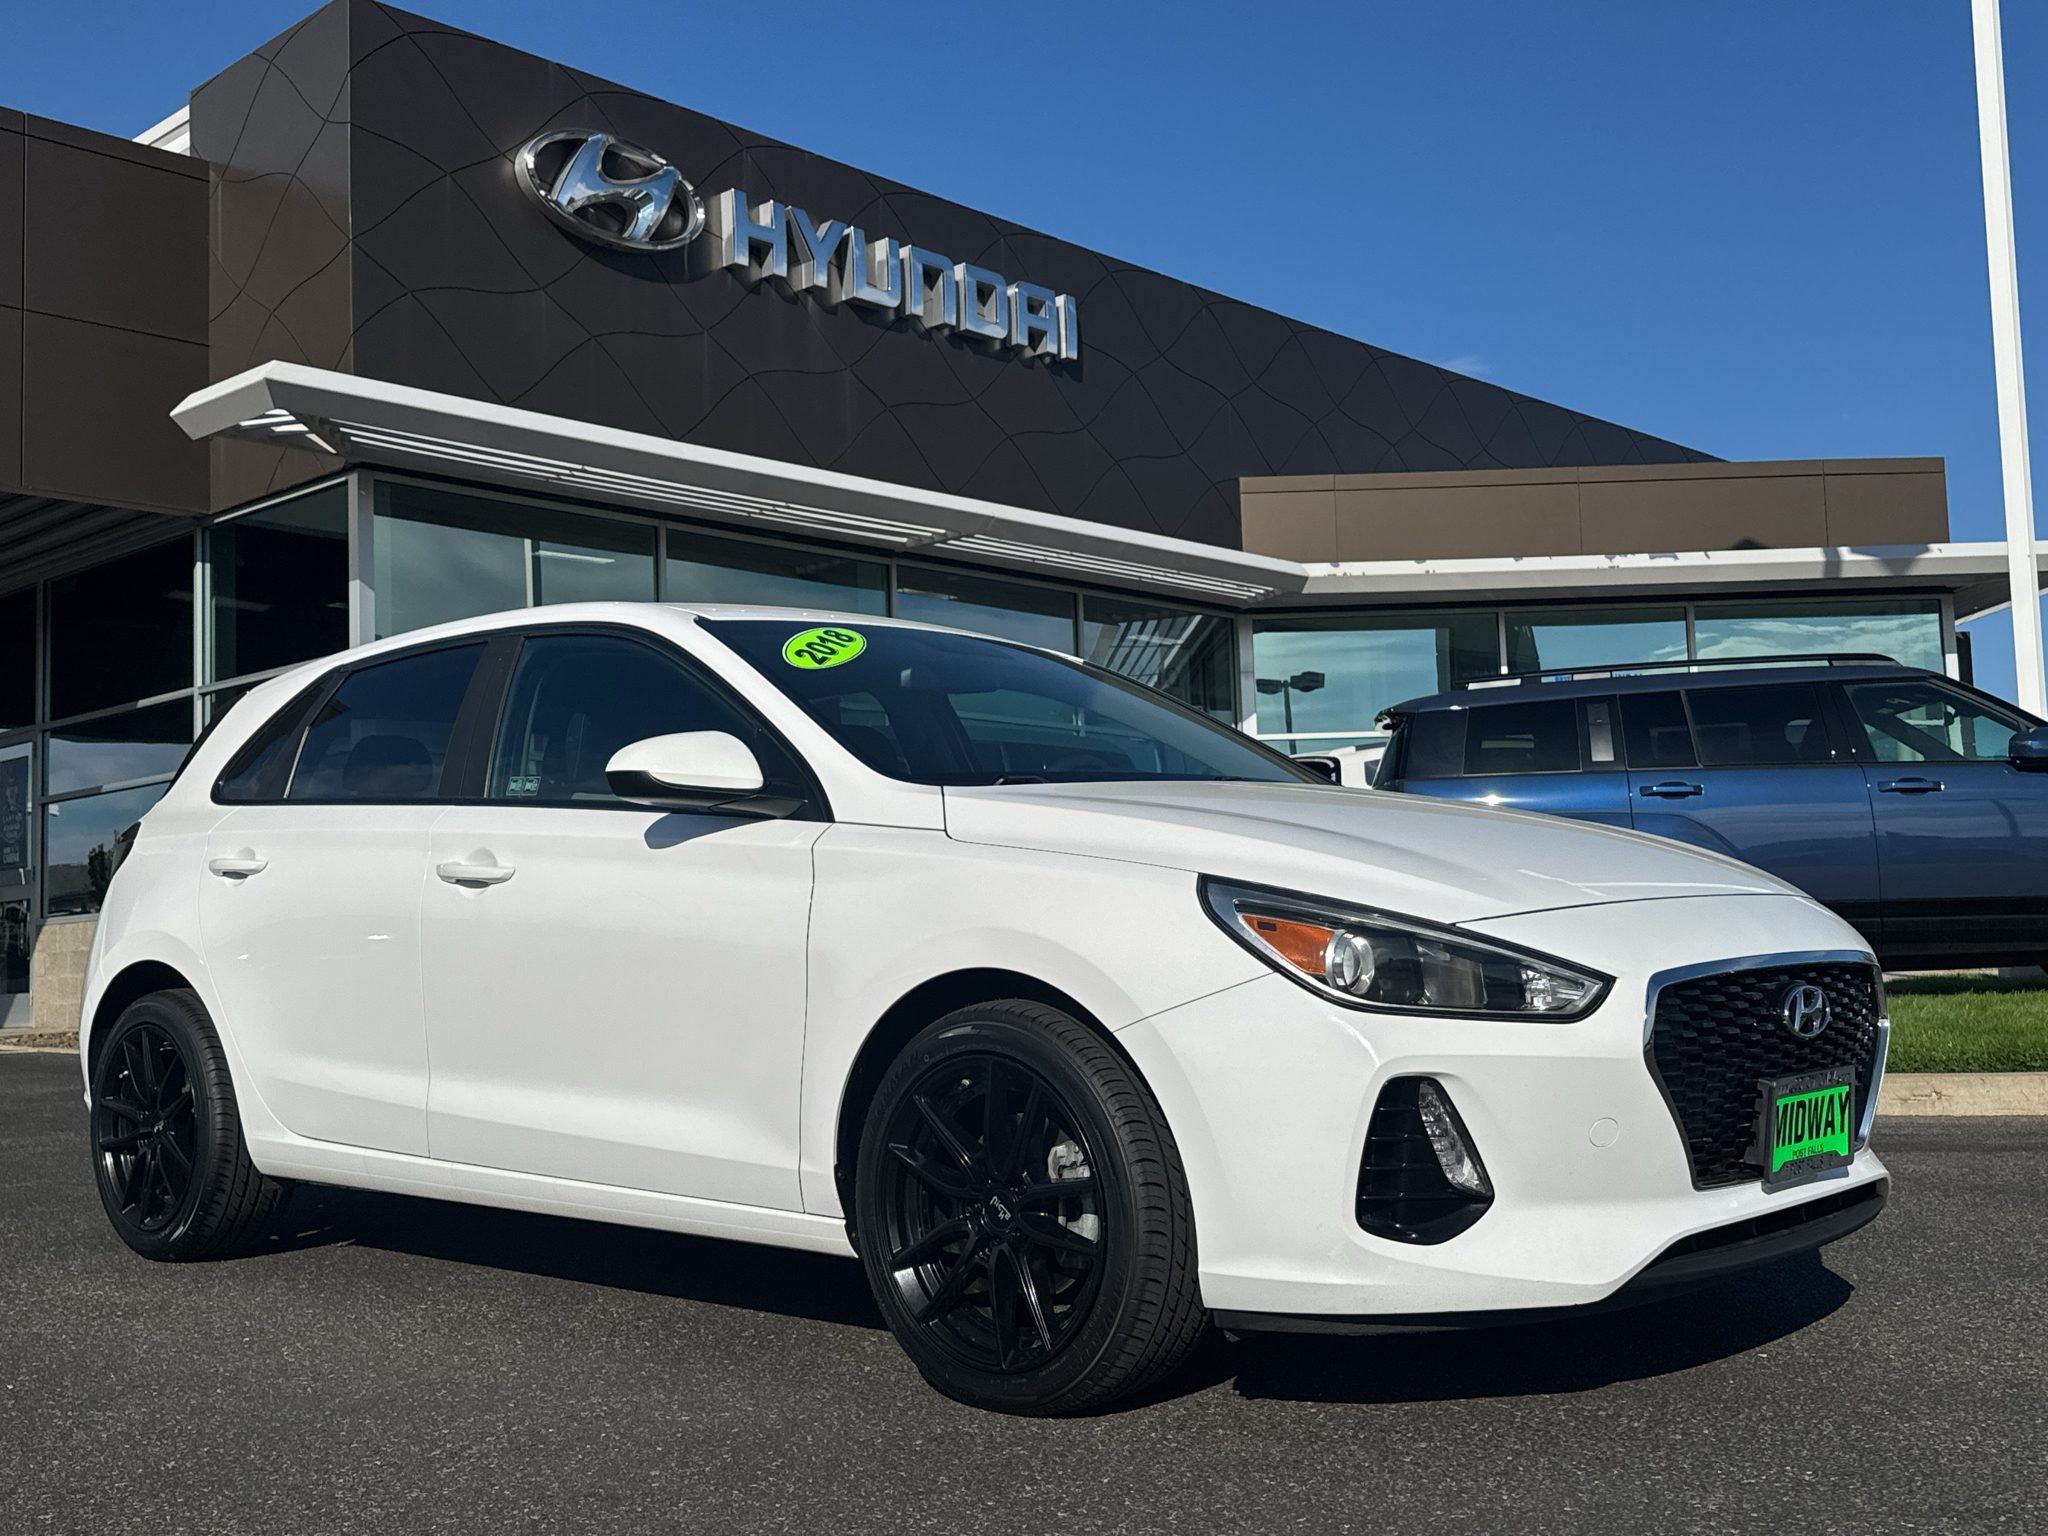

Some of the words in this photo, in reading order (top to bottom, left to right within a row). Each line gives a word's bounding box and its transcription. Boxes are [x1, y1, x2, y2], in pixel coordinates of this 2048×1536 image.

[720, 187, 1078, 361] HYUNDAI
[794, 629, 855, 665] 2018
[1775, 1091, 1850, 1149] MIDWAY
